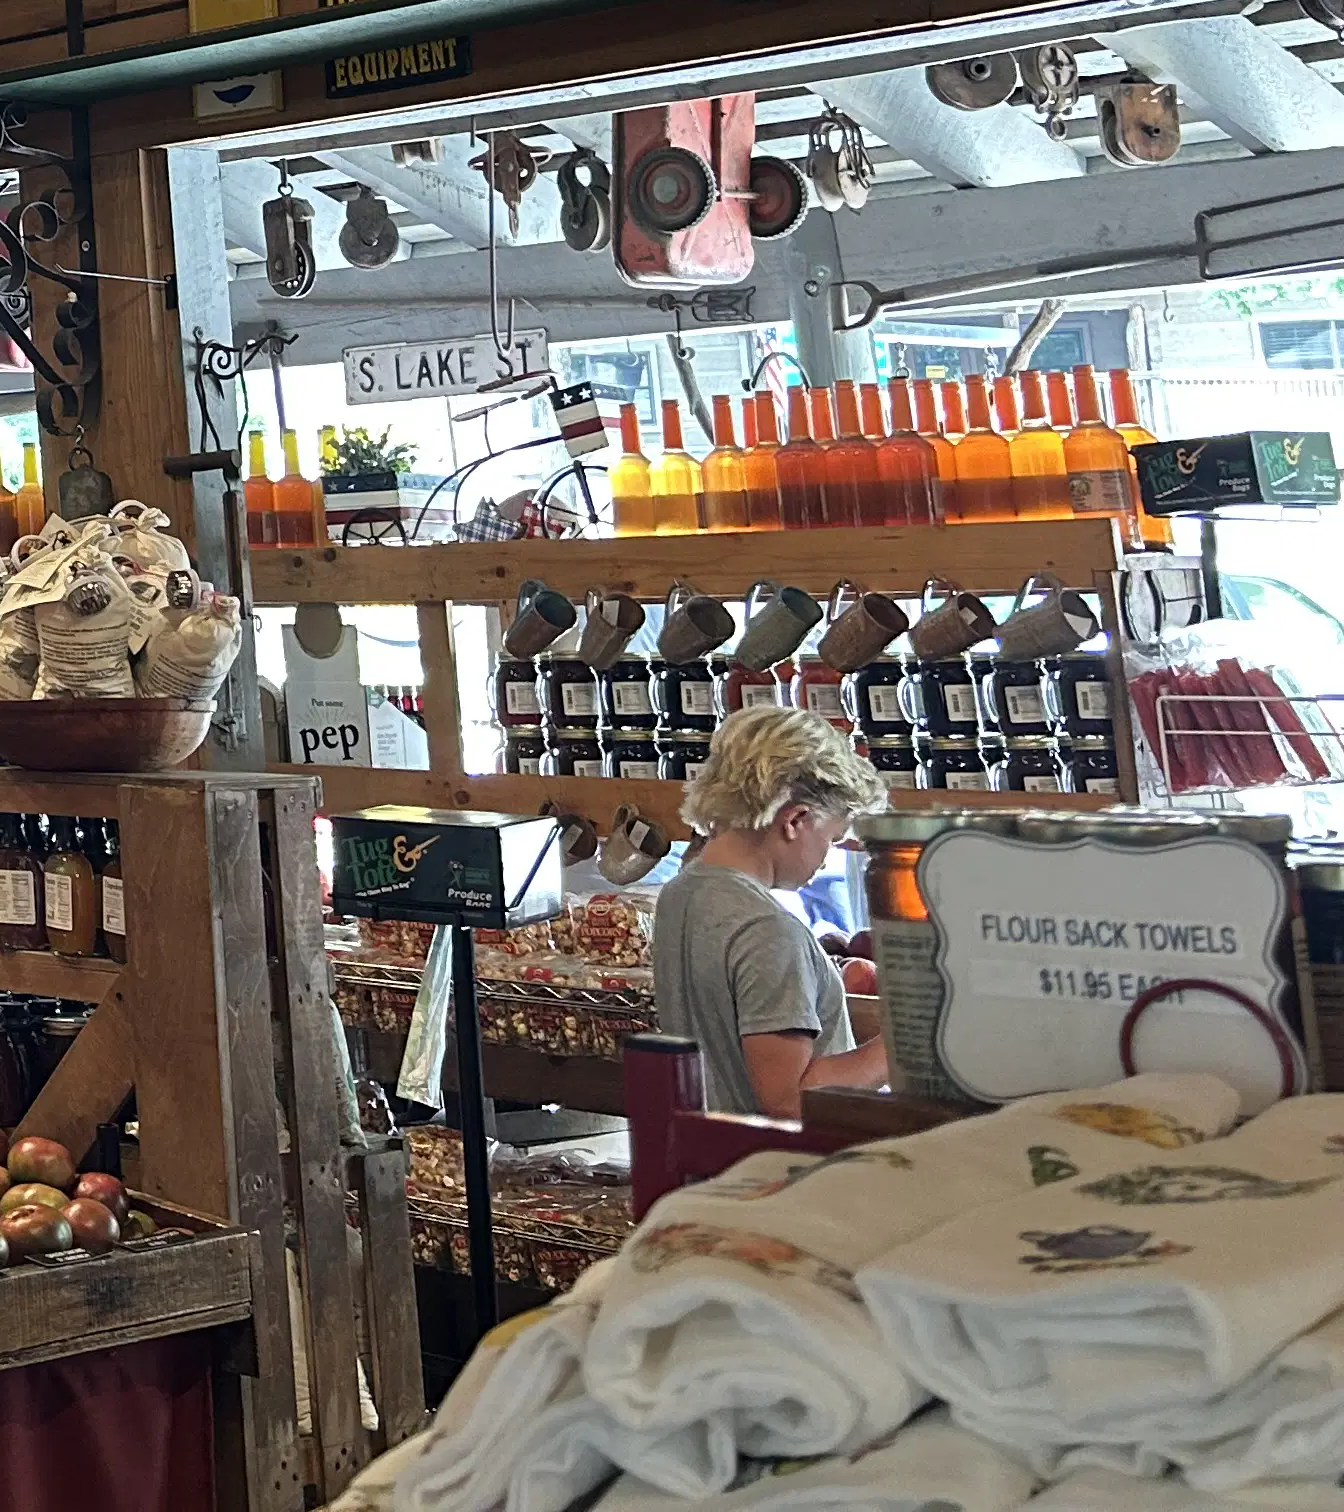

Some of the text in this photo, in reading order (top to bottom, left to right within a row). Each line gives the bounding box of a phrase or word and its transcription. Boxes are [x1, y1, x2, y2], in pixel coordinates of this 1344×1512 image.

[334, 38, 457, 88] EQUIPMENT
[359, 338, 532, 392] S. LAKE ST
[1219, 476, 1250, 487] Produce
[299, 724, 359, 764] pep
[342, 836, 389, 863] Tug
[346, 861, 397, 891] Tote
[448, 888, 492, 901] Produce
[982, 914, 1236, 954] FLOUR SACK TOWELS
[1039, 968, 1112, 1001] $11.95
